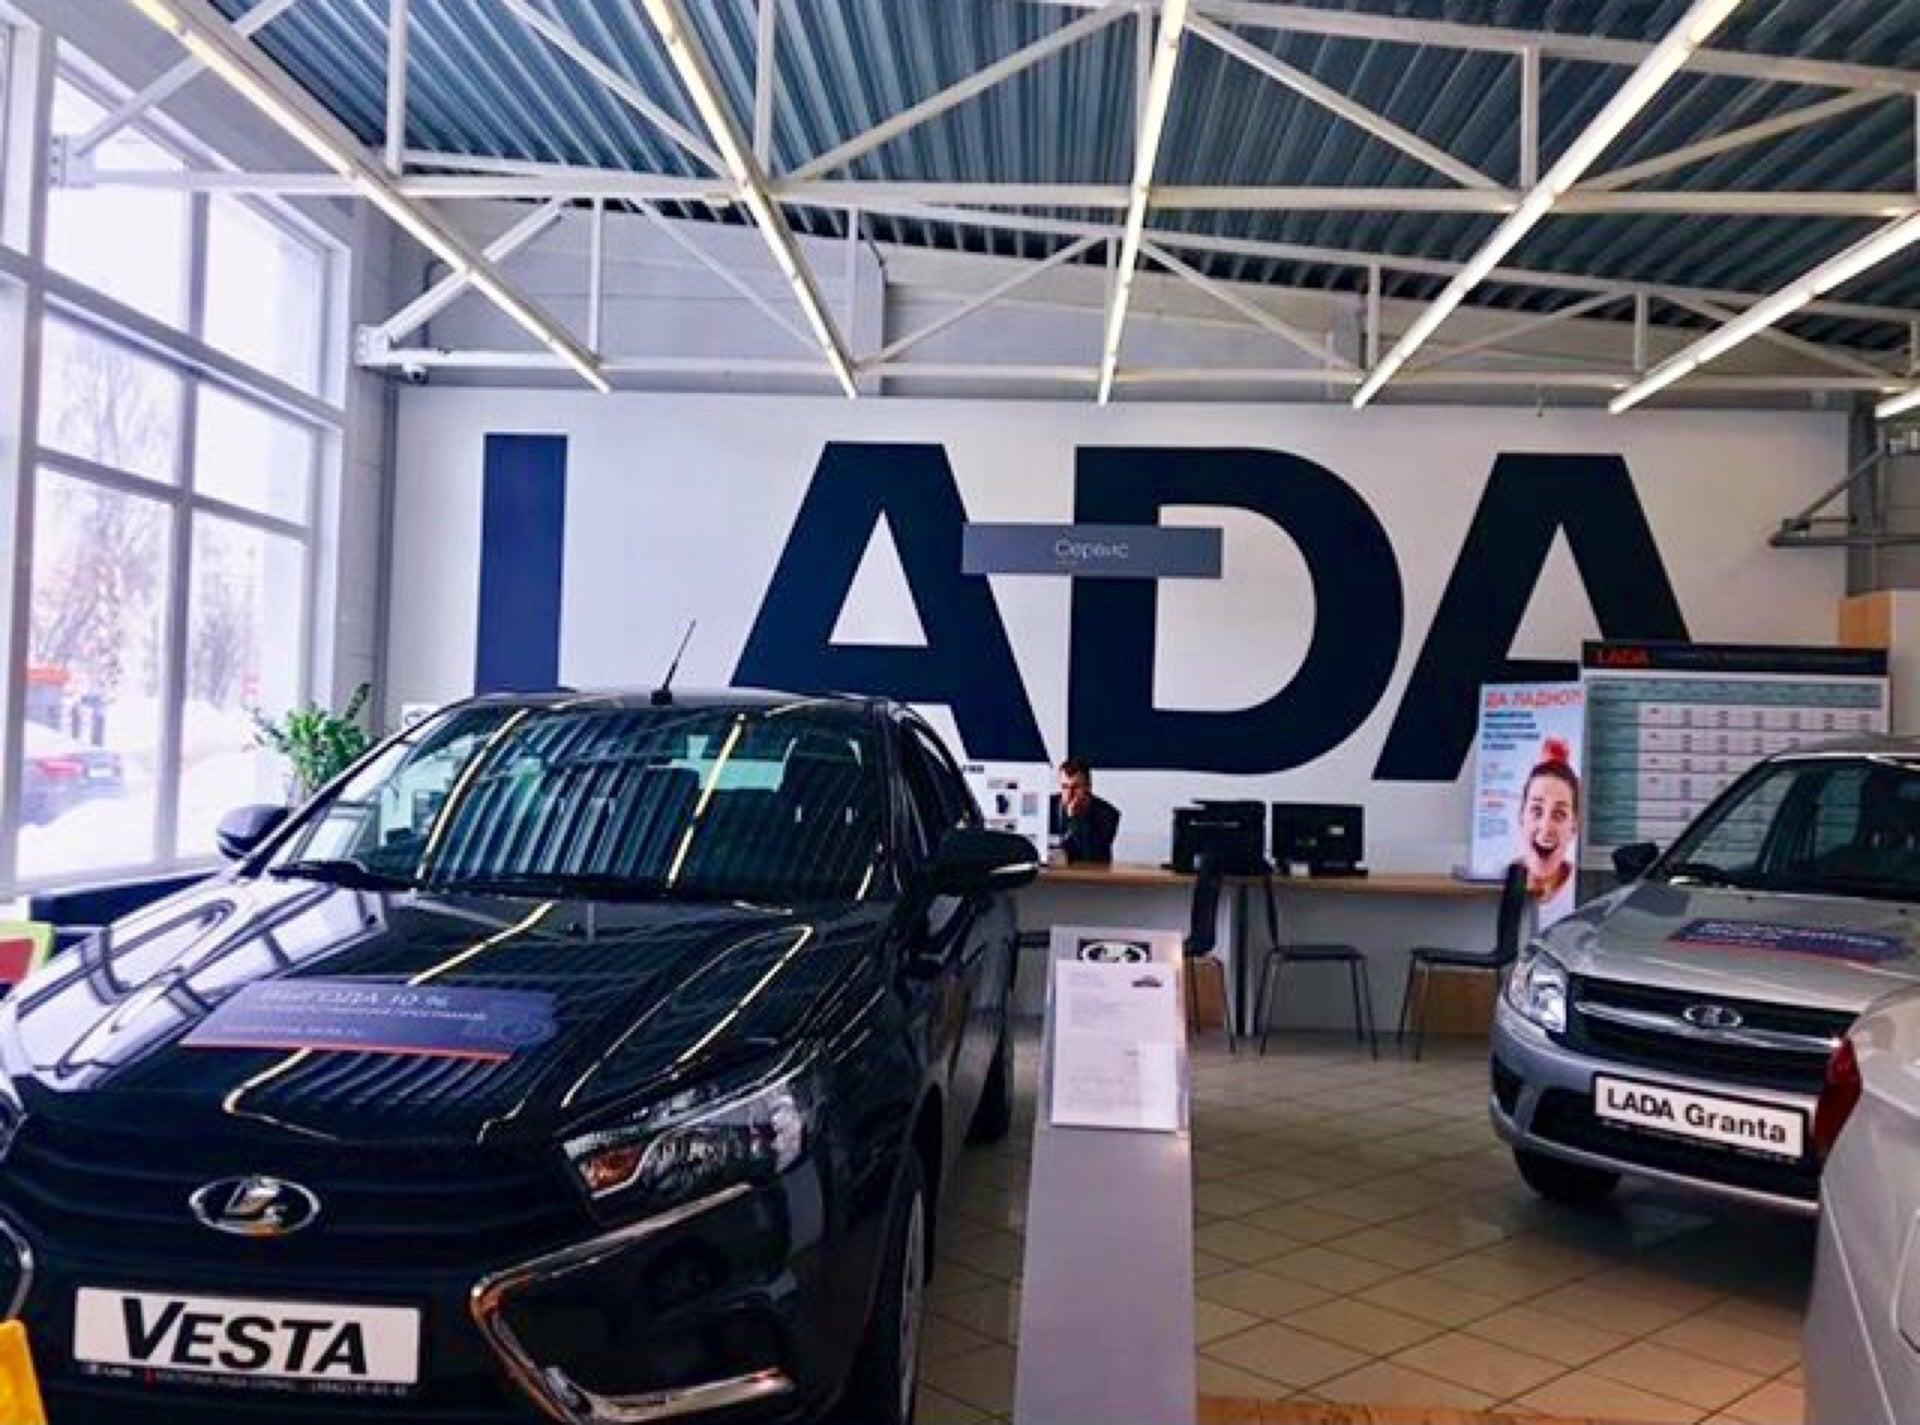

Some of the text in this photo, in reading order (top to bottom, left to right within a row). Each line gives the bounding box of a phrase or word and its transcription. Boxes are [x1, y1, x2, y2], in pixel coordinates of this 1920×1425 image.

[1055, 538, 1129, 560] Сервис
[1606, 1088, 1674, 1122] LADA
[1683, 1103, 1787, 1144] Granta
[121, 1296, 367, 1375] VESTA
